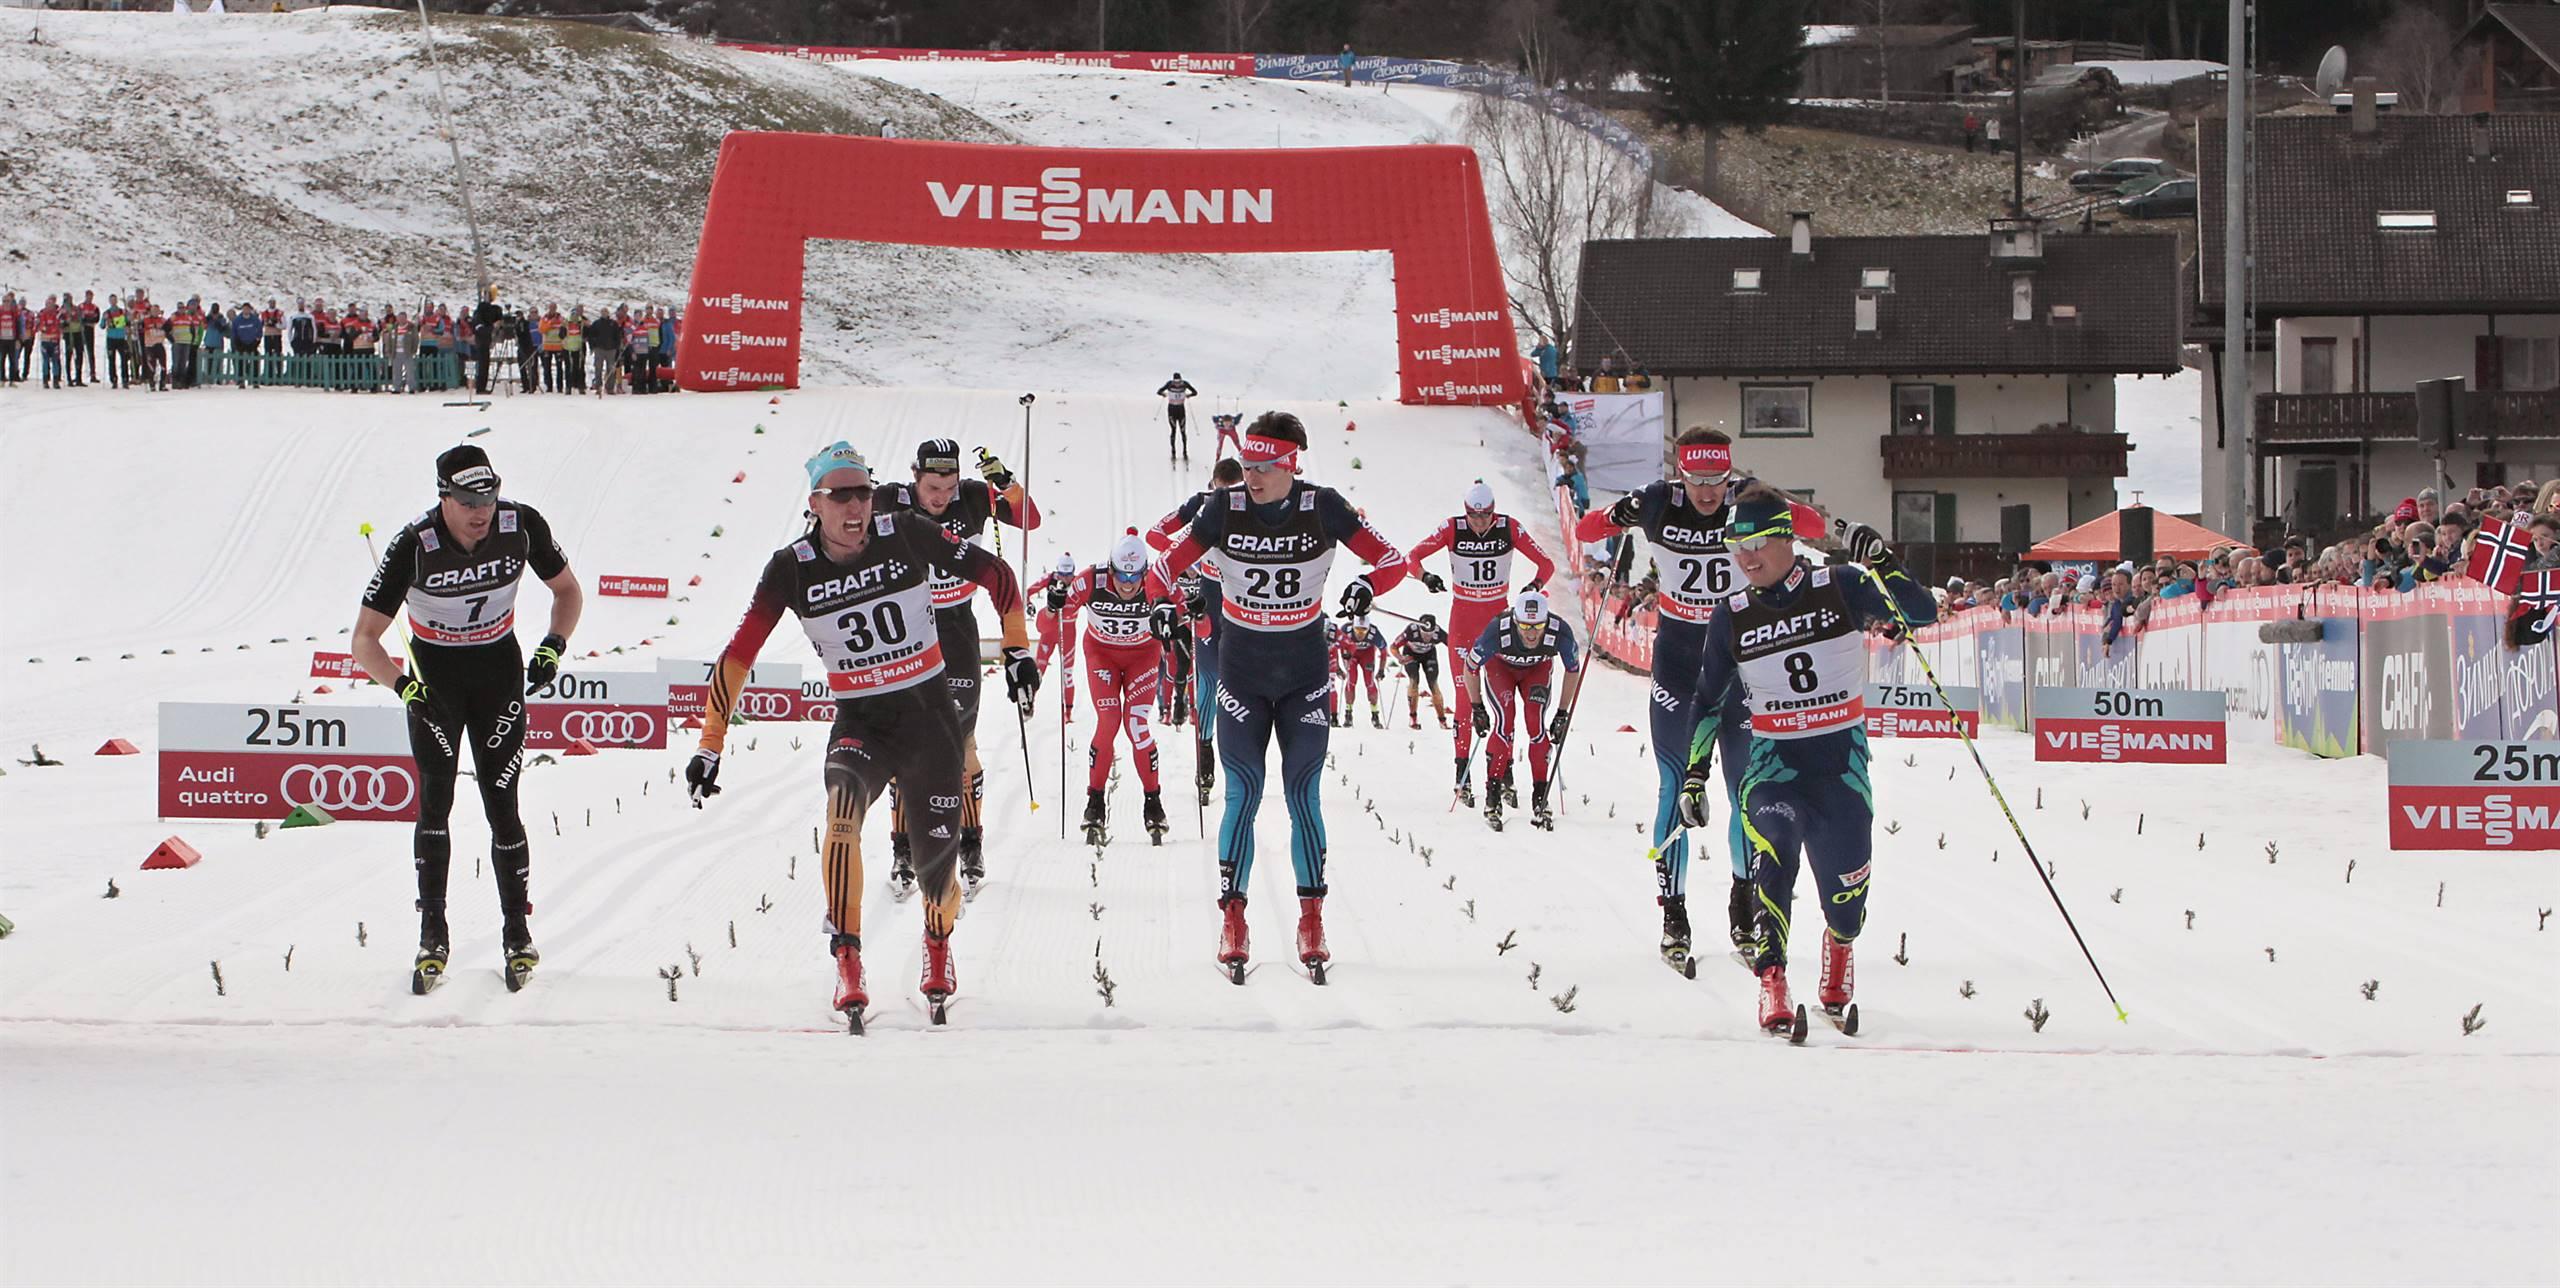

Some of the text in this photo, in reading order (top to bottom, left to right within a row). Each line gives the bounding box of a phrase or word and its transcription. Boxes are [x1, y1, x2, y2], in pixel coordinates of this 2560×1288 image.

[926, 167, 1273, 241] VIESSMANN
[702, 293, 789, 315] VIESSMANN
[1411, 308, 1499, 329] VIESSMANN
[702, 331, 787, 351] VIESSMANN
[1413, 344, 1500, 365] VIESSMANN
[700, 367, 784, 387] VIESSMANN
[1418, 381, 1503, 401] VIESSMANN
[1686, 449, 1729, 461] LUKOIL
[1227, 533, 1299, 553] CRAFT
[1662, 524, 1725, 545] CRAFT
[1457, 540, 1497, 552] CRAFT
[425, 559, 501, 588] CRAFT
[1469, 559, 1497, 582] 18
[1678, 557, 1731, 594] 26
[600, 579, 667, 595] VIESSMANN
[807, 563, 885, 603] CRAFT
[1244, 567, 1302, 600] 28
[465, 595, 489, 623] 7
[1091, 601, 1140, 613] CRAFT
[1239, 610, 1308, 626] VIESSMANN
[837, 600, 907, 654] 30
[1101, 618, 1140, 635] 33
[1740, 611, 1817, 648] CRAFT
[838, 640, 924, 671] fiemme
[313, 658, 367, 677] VIESSM
[848, 658, 924, 687] VIESSMANN
[1783, 651, 1819, 694] 8
[1765, 690, 1849, 712] fiemme
[1878, 685, 1932, 707] 75m
[2094, 691, 2164, 717] 50m
[245, 707, 347, 747] 25m
[487, 700, 522, 749] odlo
[1772, 708, 1849, 730] VIESSMANN
[1867, 712, 1969, 738] ESSMANN
[2044, 724, 2214, 761] VIESSMANN
[178, 766, 236, 783] Audi
[178, 788, 269, 807] quattro
